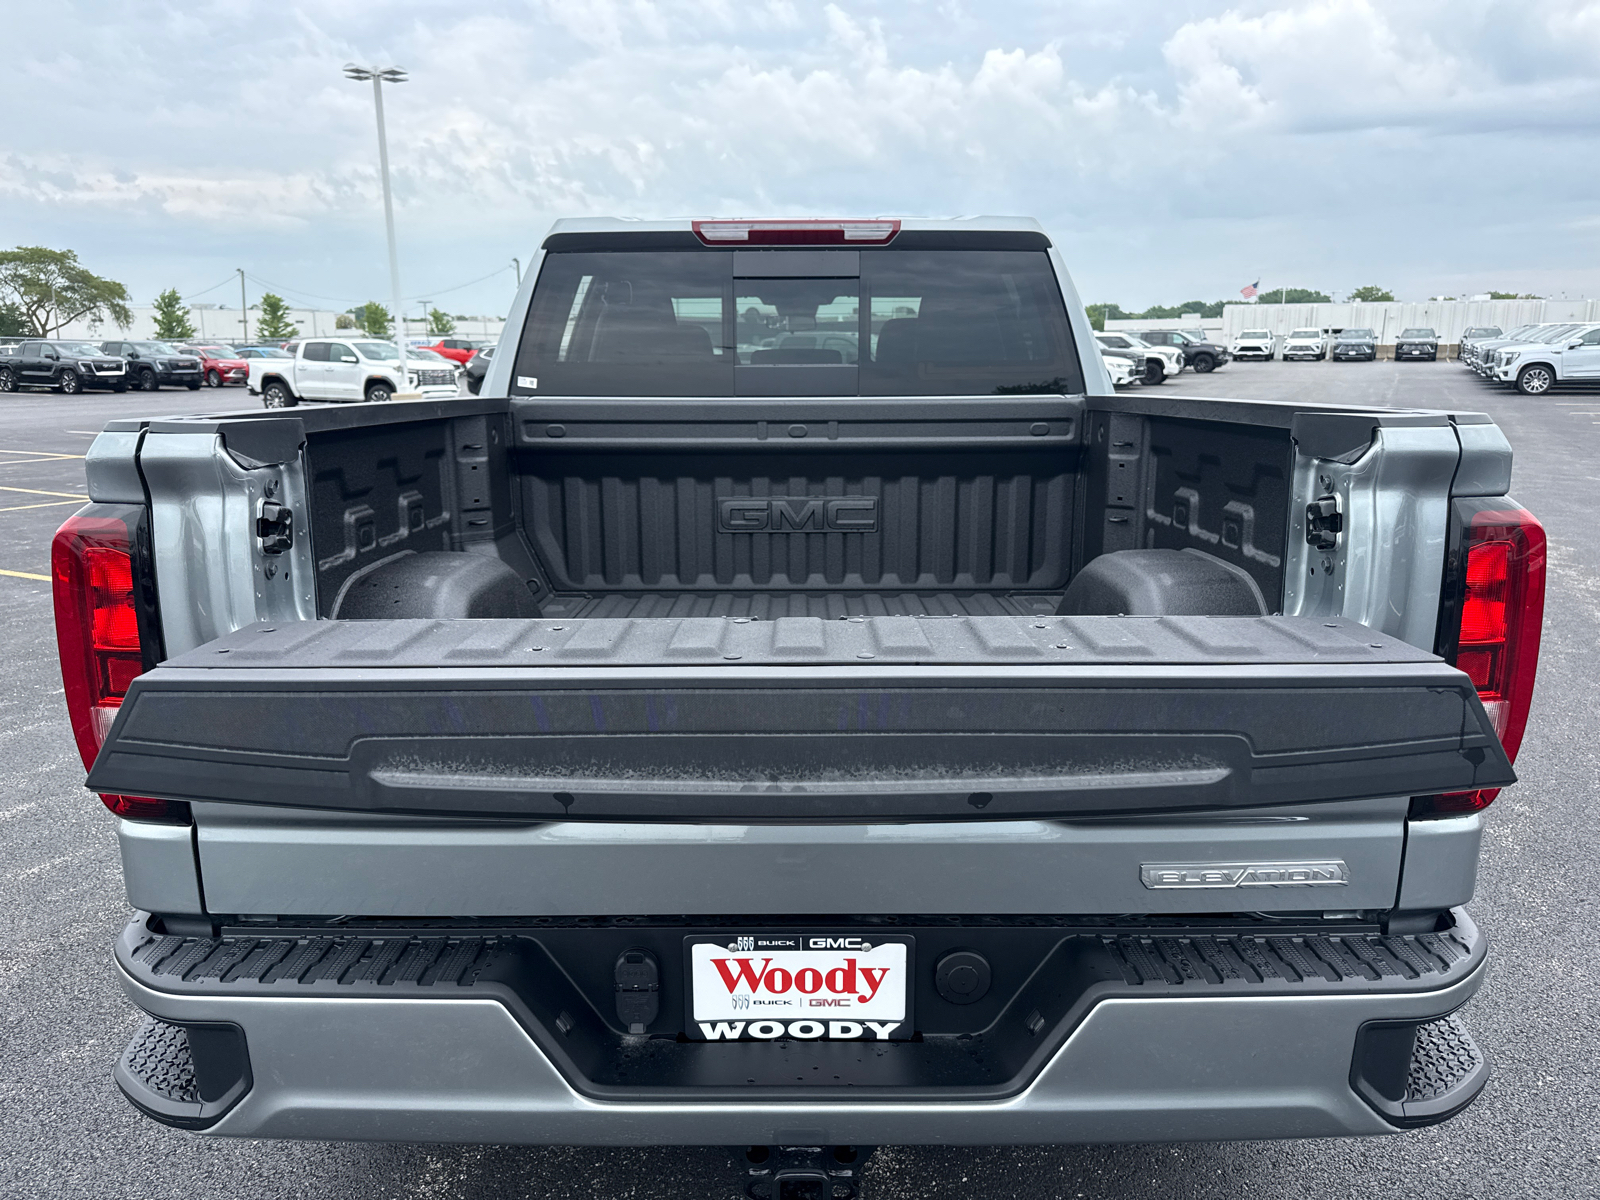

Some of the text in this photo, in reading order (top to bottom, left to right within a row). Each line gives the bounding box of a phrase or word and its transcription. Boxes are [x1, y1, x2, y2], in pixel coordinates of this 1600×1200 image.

[720, 500, 876, 531] GMC
[1157, 867, 1335, 884] ELEVATION
[809, 937, 862, 949] GMC
[709, 957, 891, 1004] Woody
[808, 998, 851, 1007] GMC
[698, 1020, 901, 1040] WOODY
